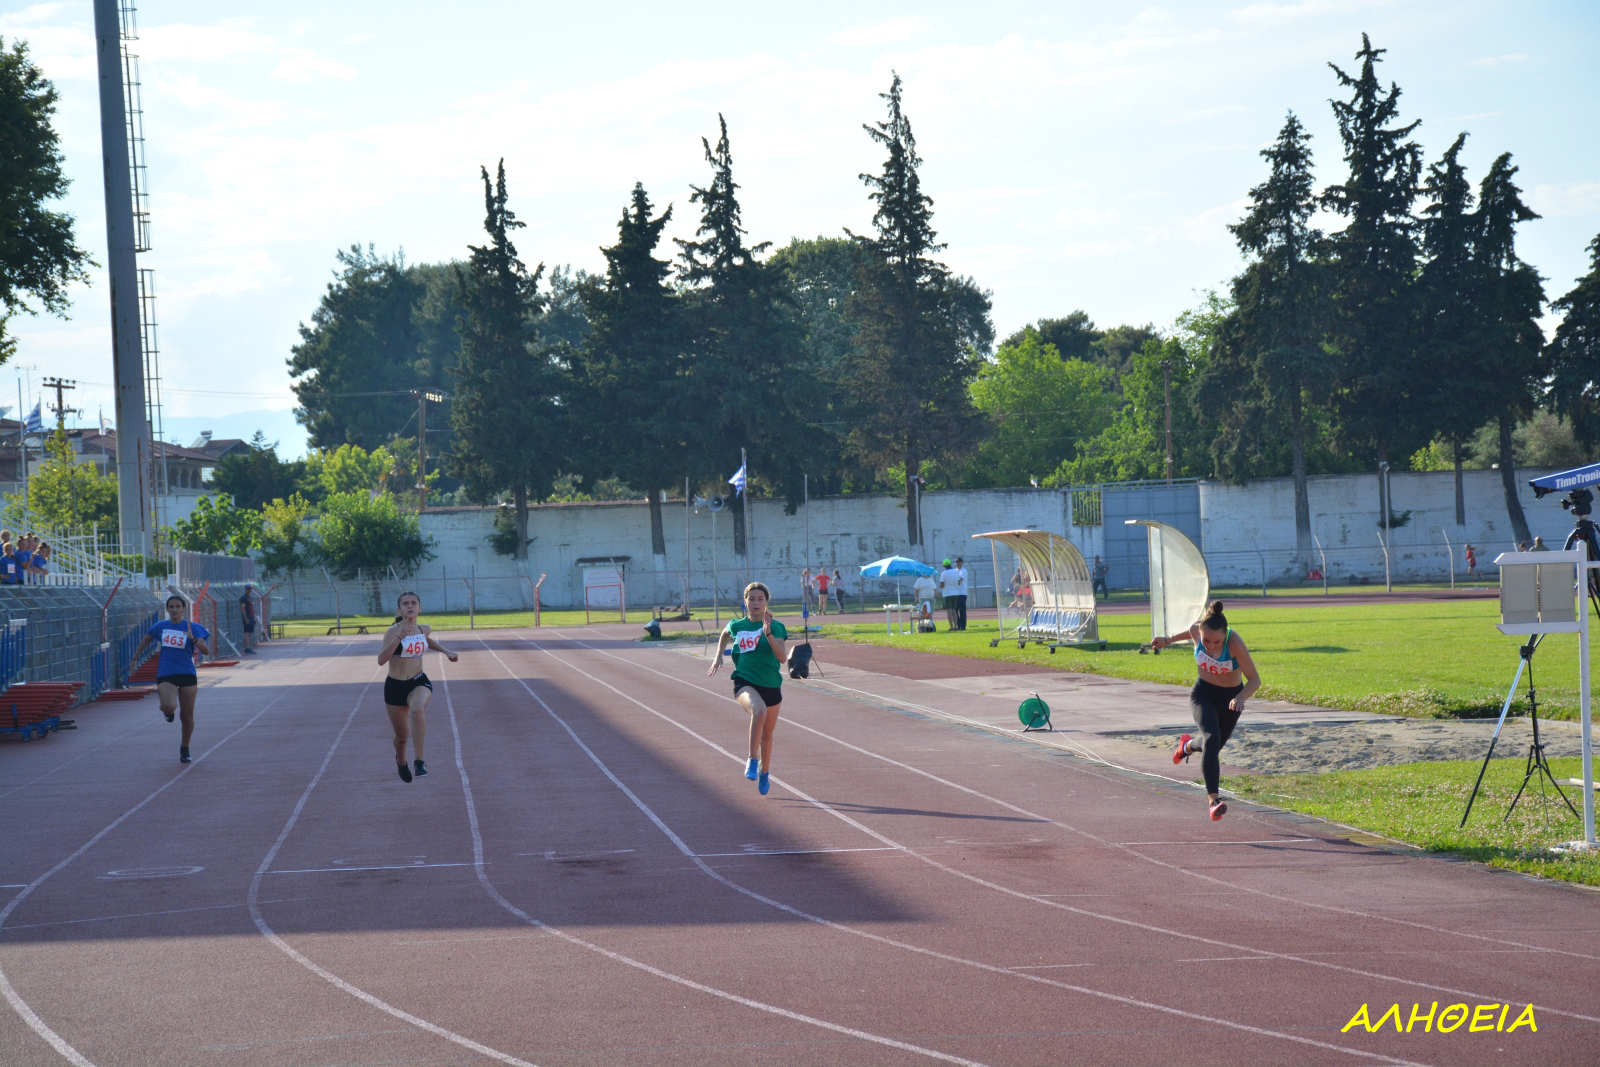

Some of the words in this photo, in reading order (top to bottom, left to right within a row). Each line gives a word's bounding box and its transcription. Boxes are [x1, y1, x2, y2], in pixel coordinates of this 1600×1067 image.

[1555, 469, 1600, 489] TimeTroni
[163, 635, 185, 647] 463
[406, 641, 425, 655] 461
